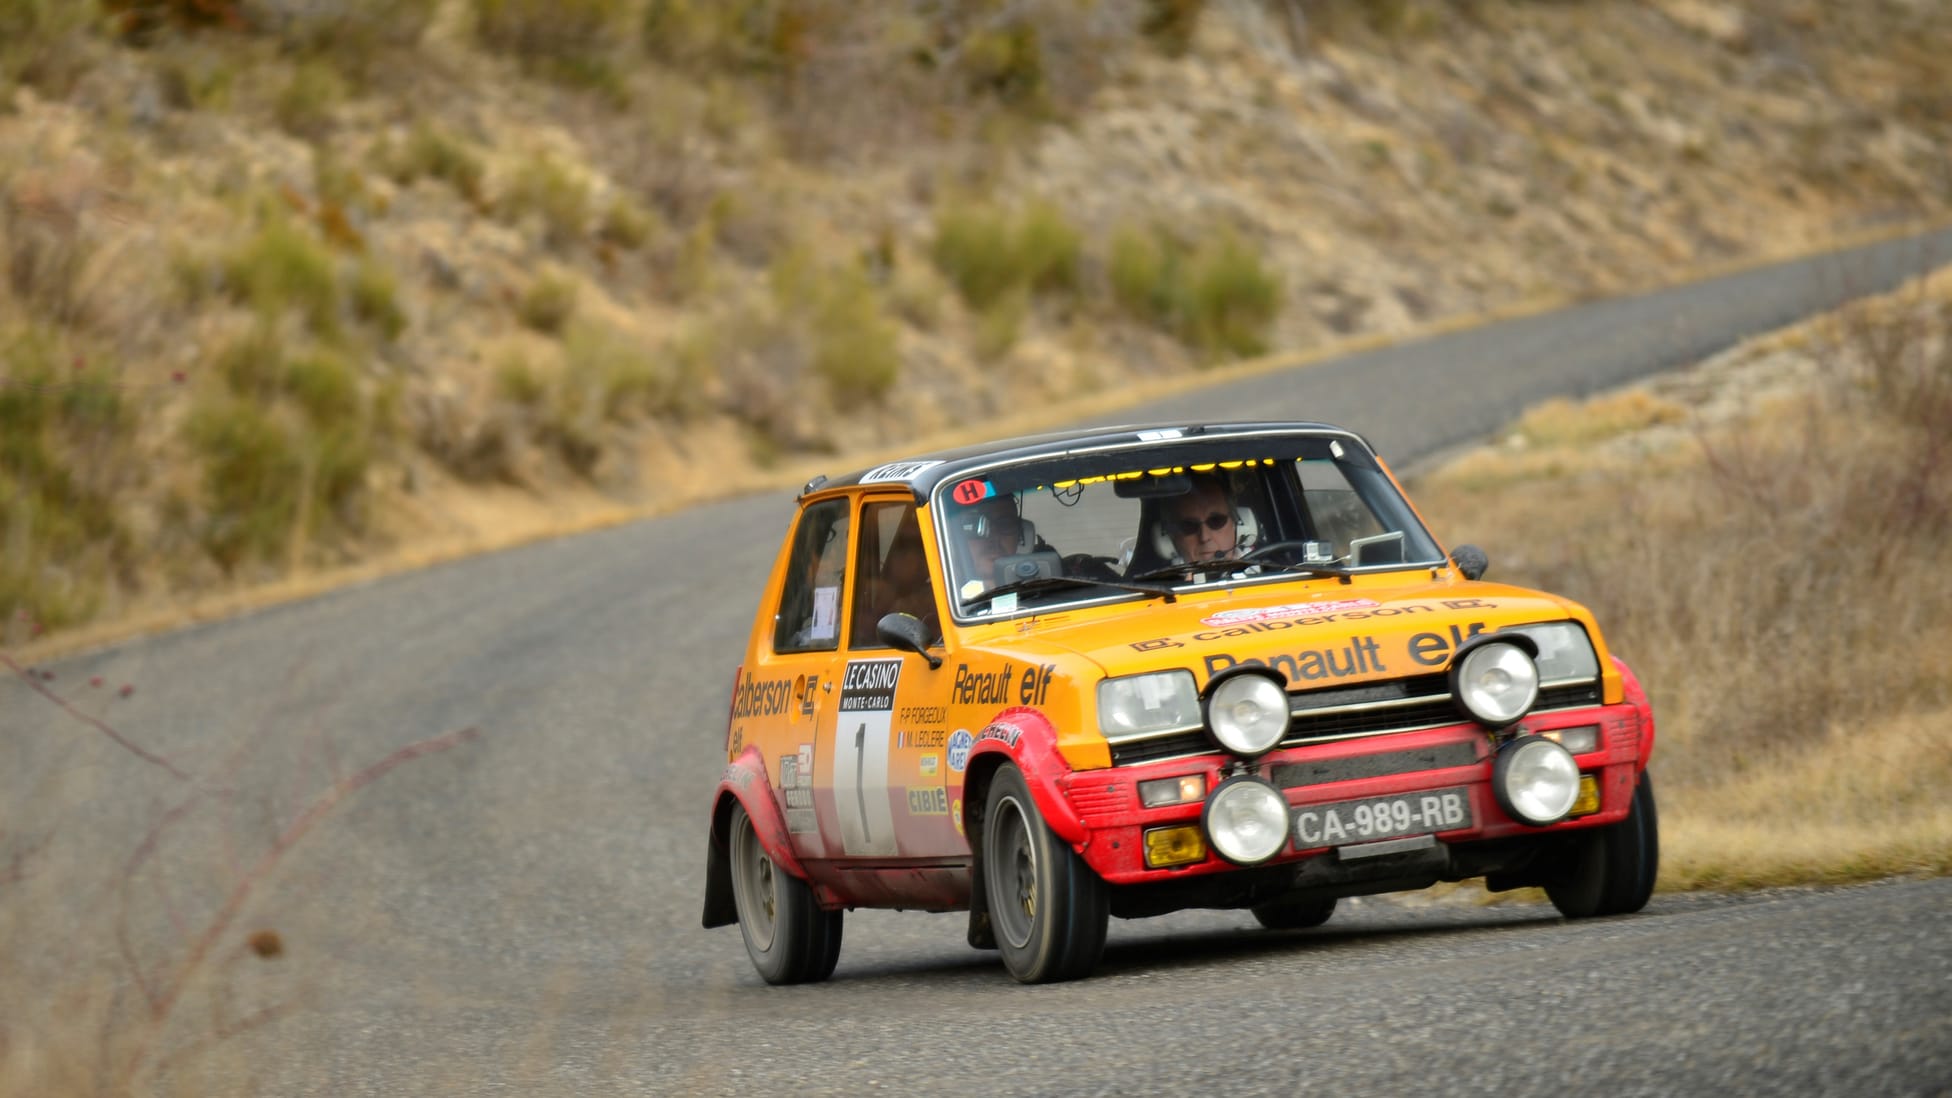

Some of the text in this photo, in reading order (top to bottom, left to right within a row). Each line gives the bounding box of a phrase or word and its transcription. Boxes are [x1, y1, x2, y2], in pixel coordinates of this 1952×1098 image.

[962, 483, 978, 501] H
[1192, 605, 1435, 641] calberson
[843, 660, 898, 690] LE CASINO
[1204, 636, 1385, 682] Rnault
[951, 663, 1056, 706] Renault elf
[855, 722, 871, 844] 1
[1297, 794, 1463, 842] CA-989-RB
